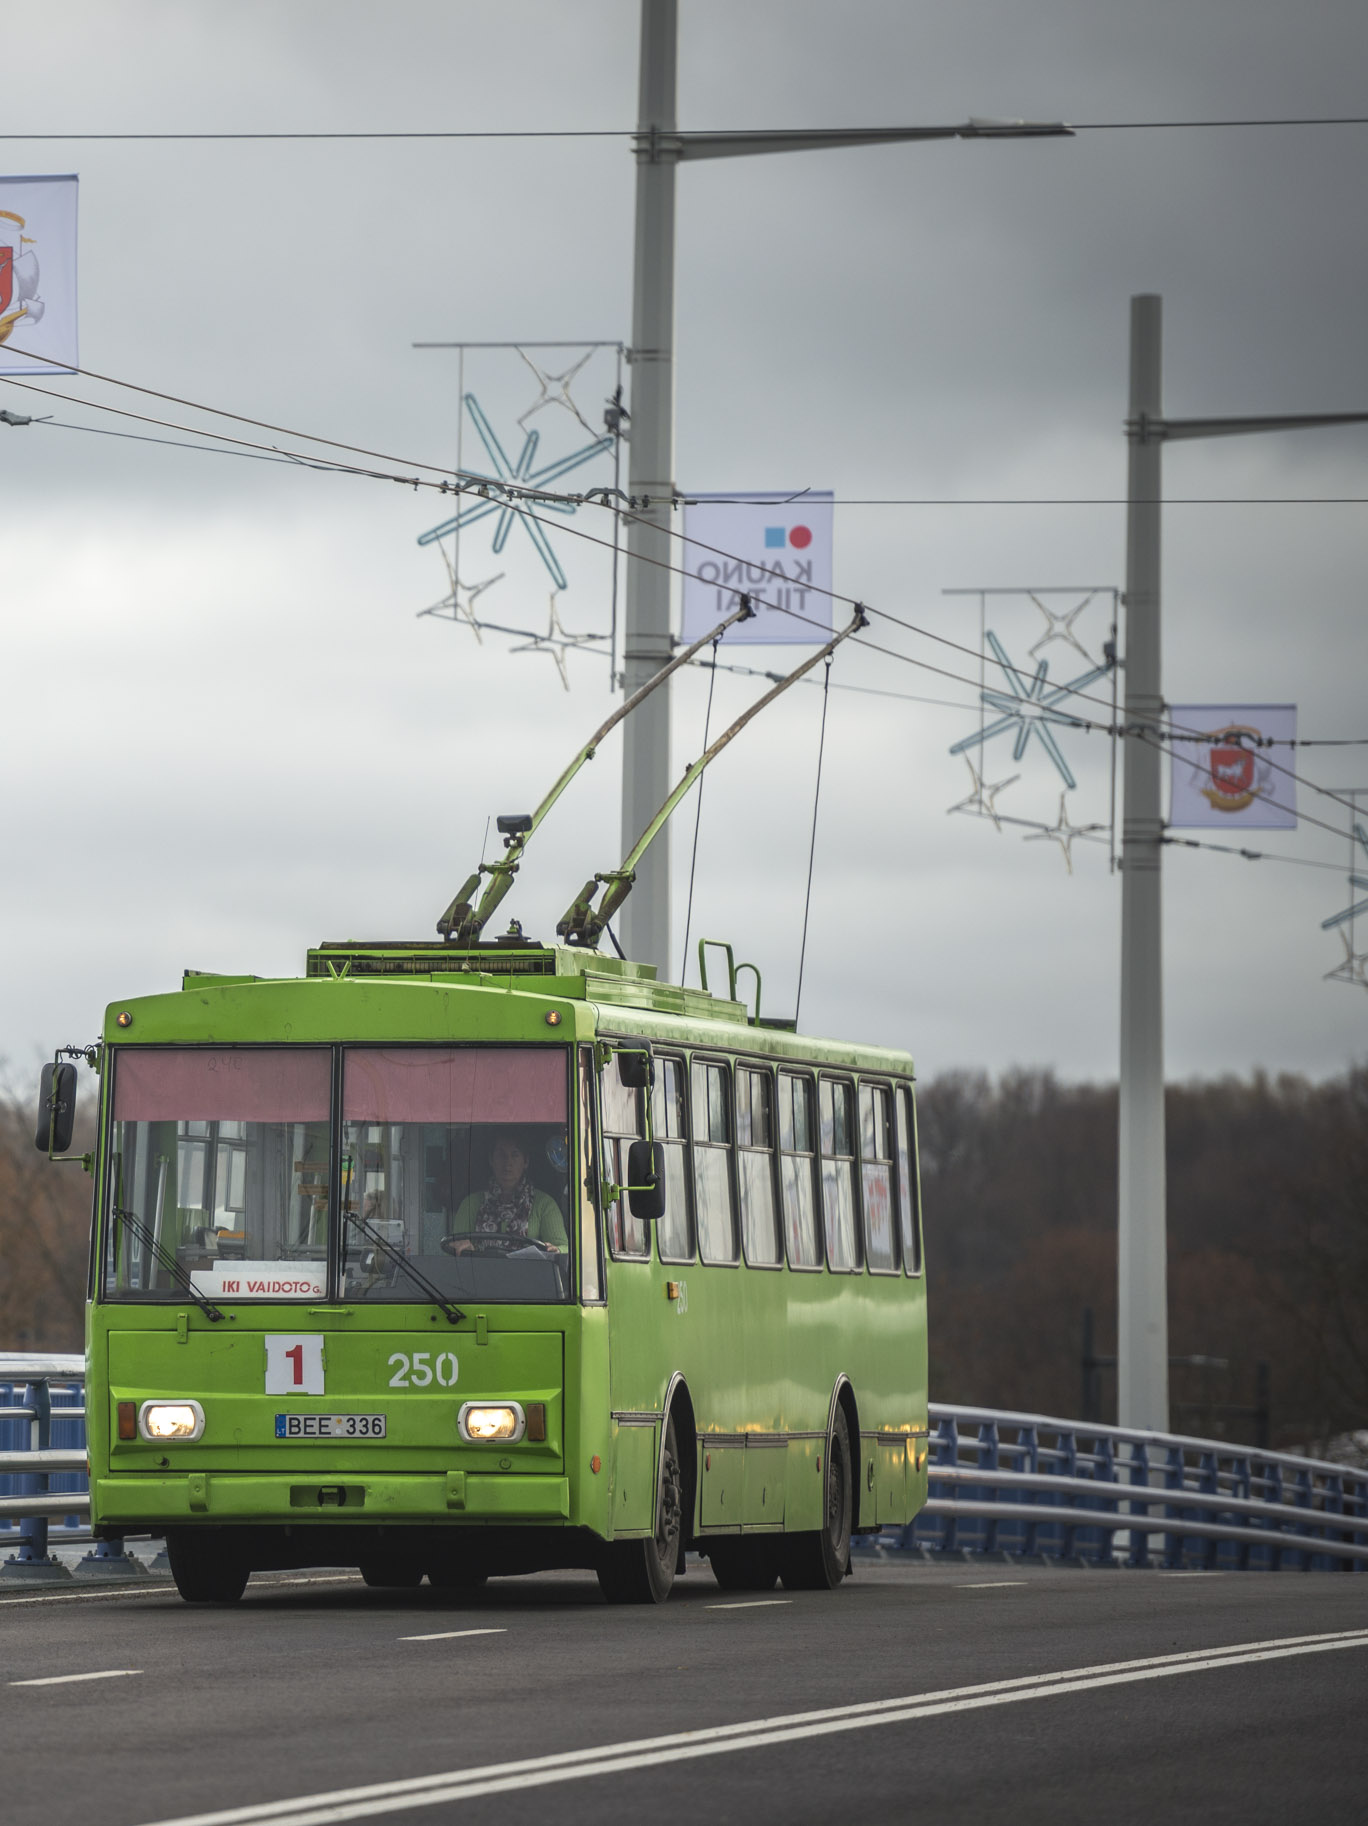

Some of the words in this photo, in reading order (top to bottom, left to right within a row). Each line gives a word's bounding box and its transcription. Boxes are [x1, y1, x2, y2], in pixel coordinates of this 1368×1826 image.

[222, 1280, 241, 1293] IKI
[246, 1280, 311, 1294] VAIDOTO
[285, 1344, 304, 1385] 1
[387, 1352, 460, 1388] 250
[288, 1416, 332, 1436] BEE
[345, 1416, 384, 1436] 336
